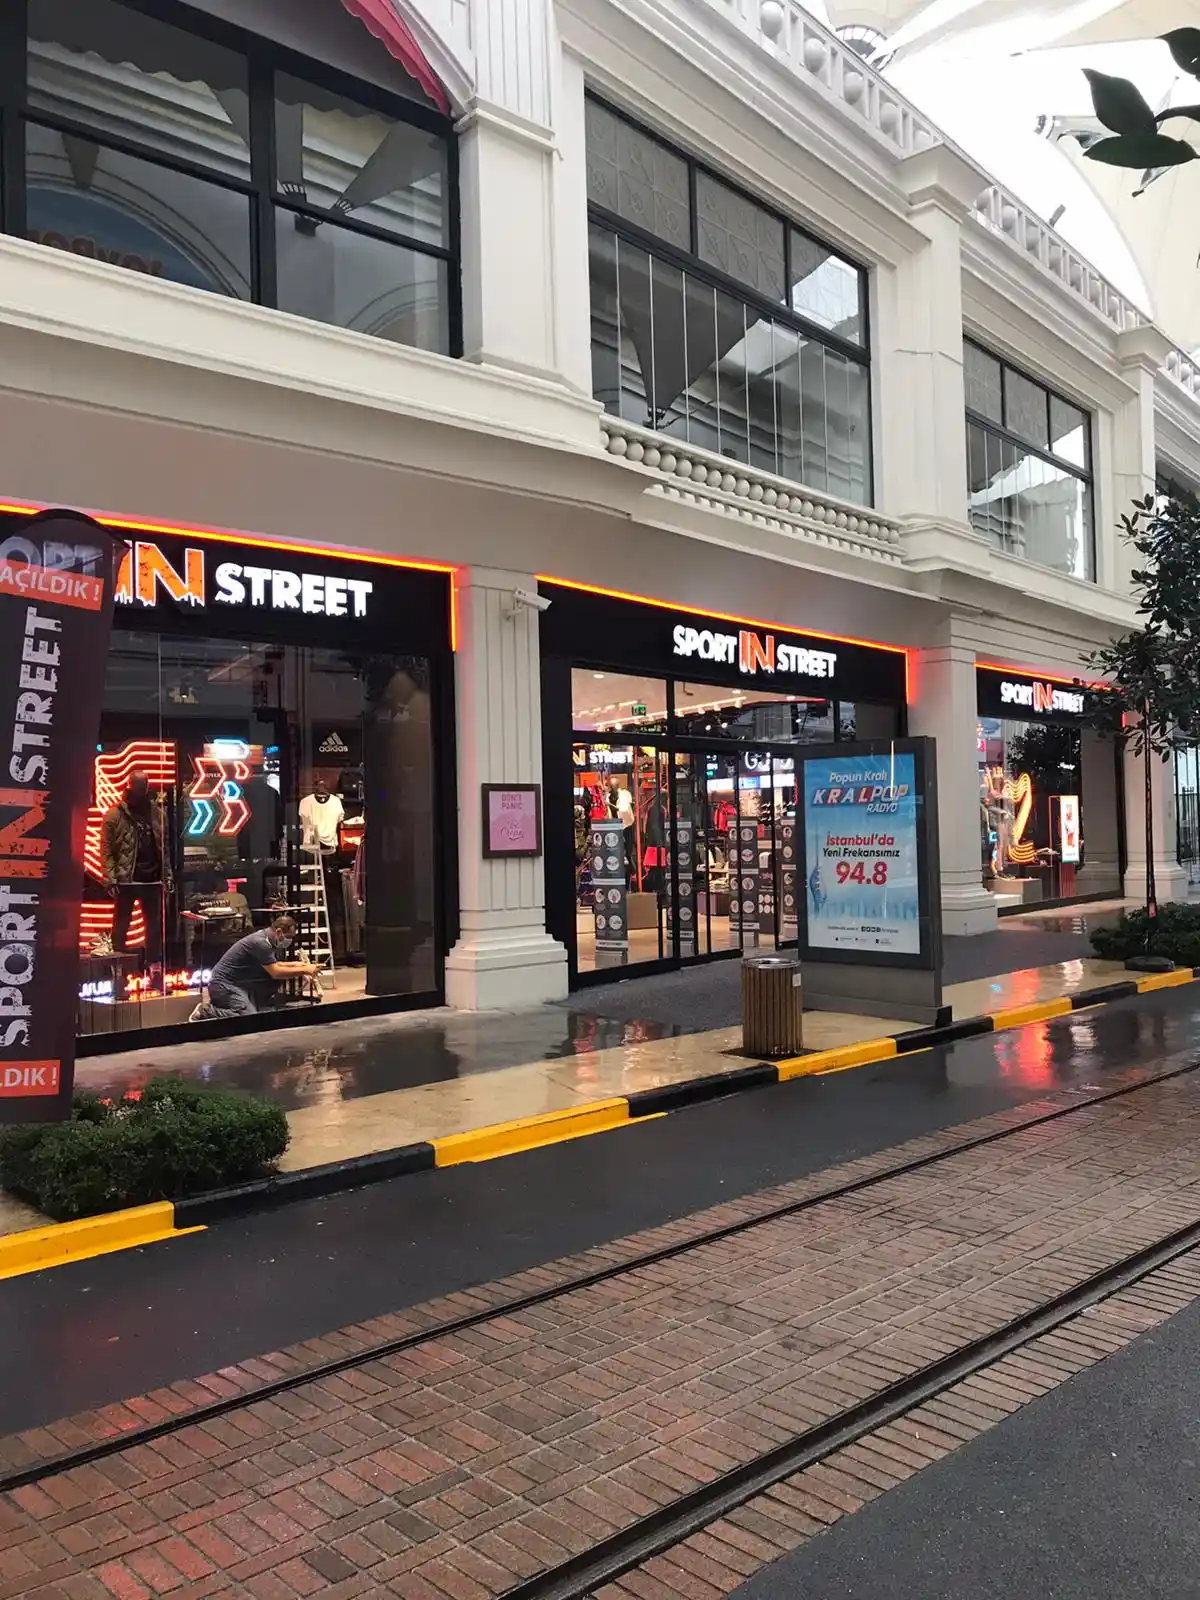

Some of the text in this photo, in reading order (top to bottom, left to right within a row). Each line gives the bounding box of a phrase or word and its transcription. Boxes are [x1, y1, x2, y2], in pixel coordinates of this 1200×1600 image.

[114, 540, 205, 607] IN
[215, 562, 373, 617] STREET
[673, 624, 837, 678] SPORT IN STREET
[9, 606, 62, 786] STREET
[1000, 681, 1084, 713] SPORT IN STREET
[318, 744, 349, 753] adidas
[829, 772, 861, 784] Popun
[866, 803, 898, 813] RADYO
[823, 848, 841, 858] Yeni
[836, 861, 888, 885] 94.8
[0, 885, 40, 1047] SPORT
